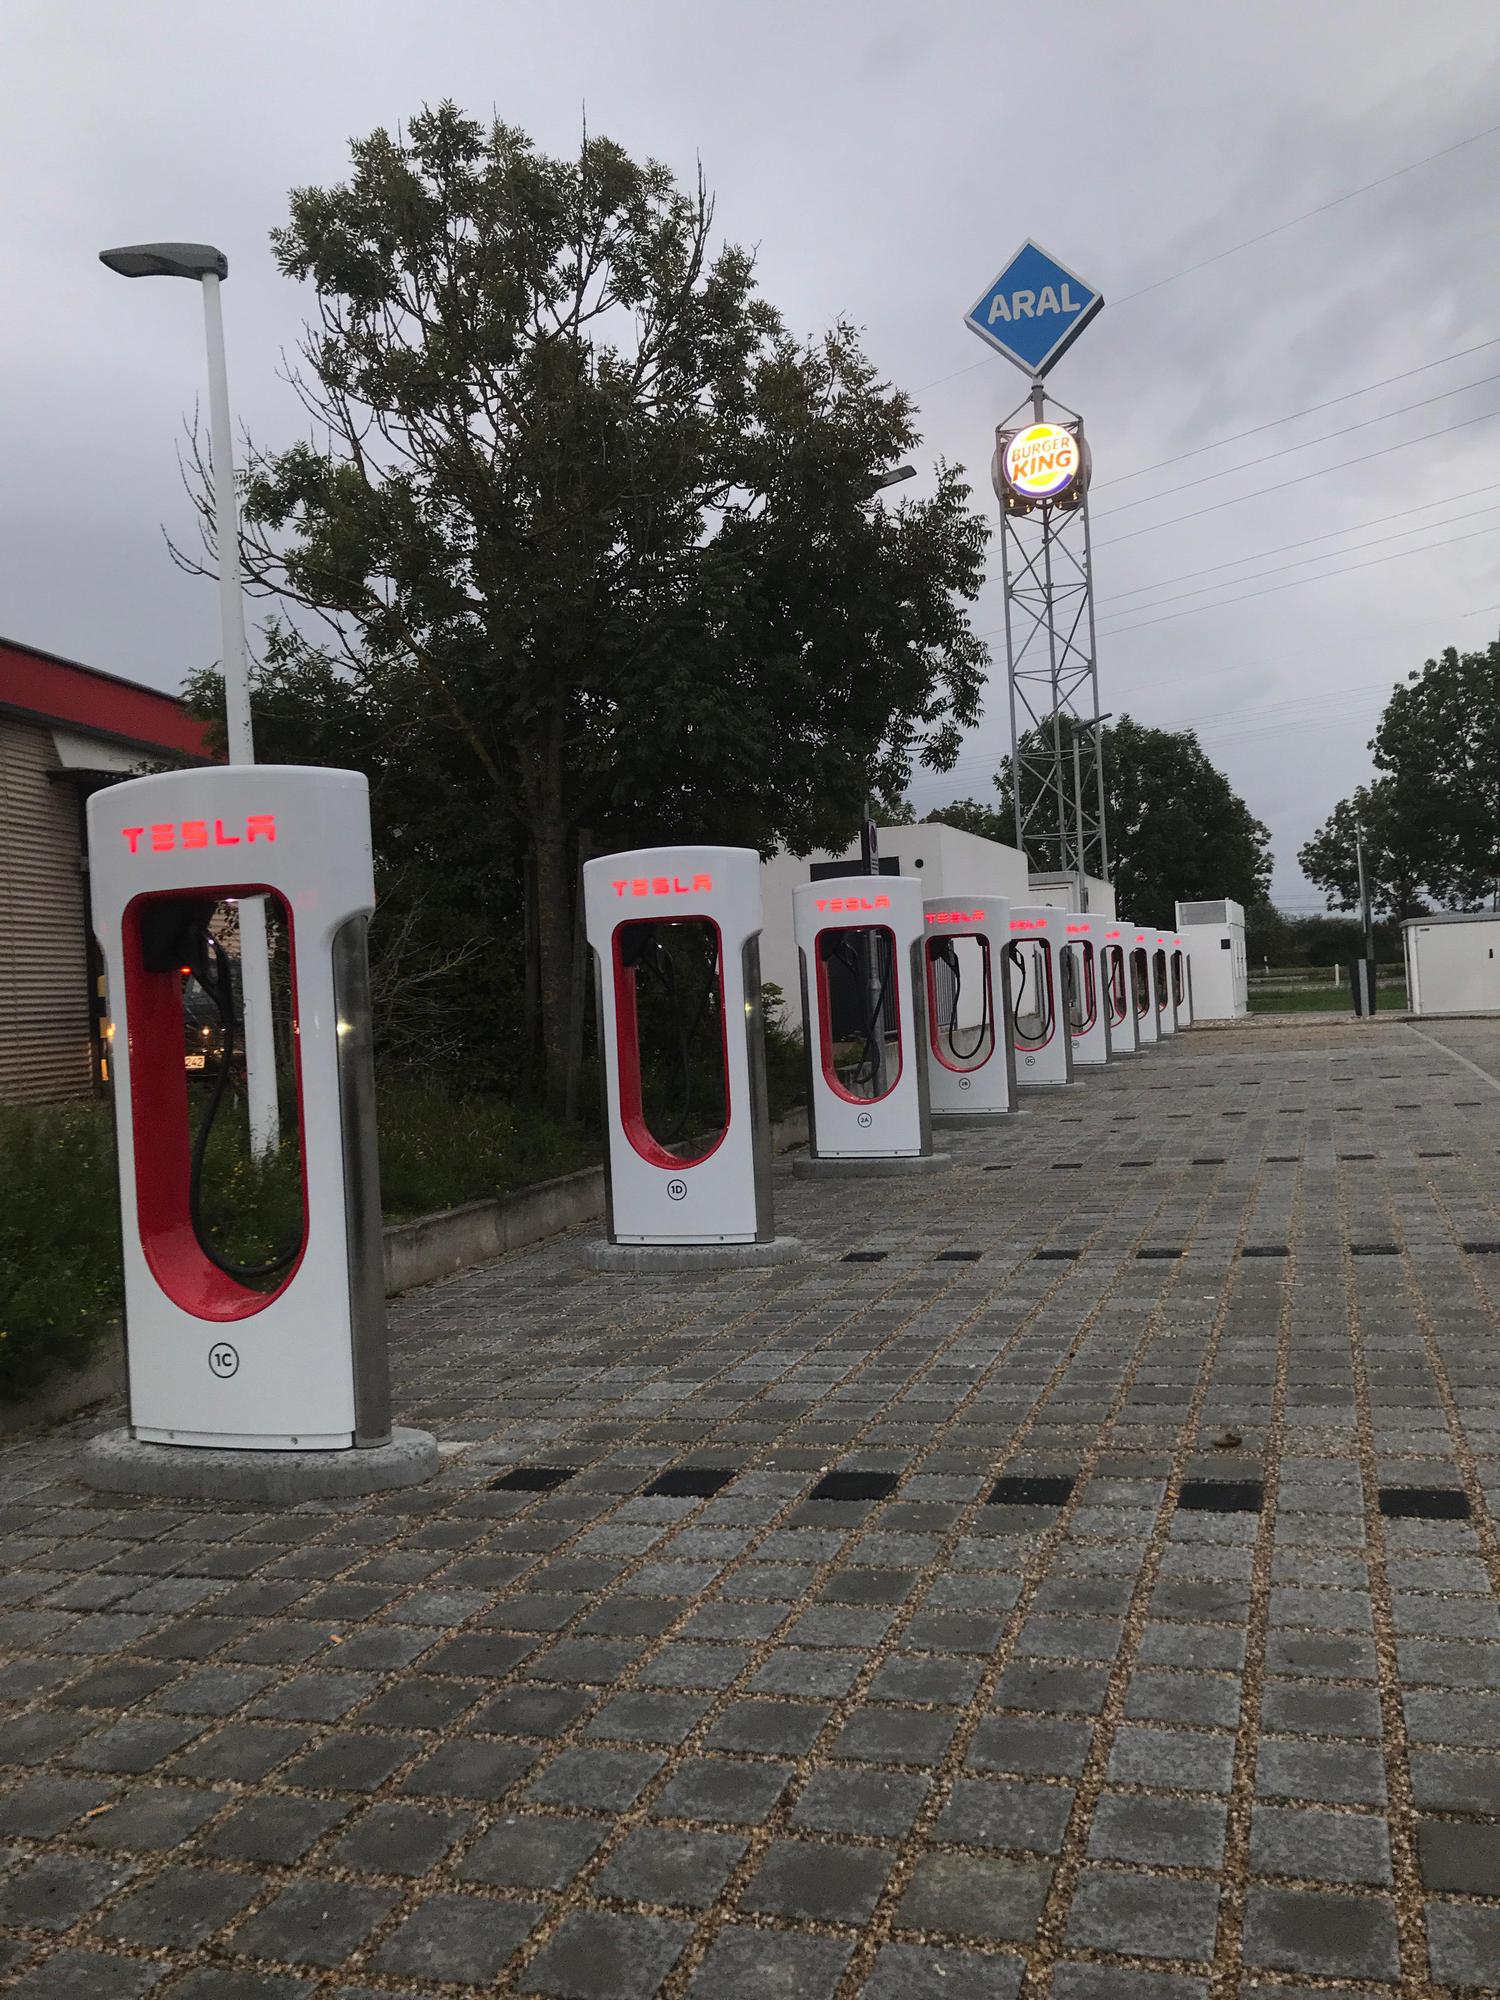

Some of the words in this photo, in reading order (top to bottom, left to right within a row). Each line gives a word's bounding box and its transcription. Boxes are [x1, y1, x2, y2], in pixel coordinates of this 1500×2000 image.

[987, 282, 1081, 325] ARAL
[1012, 437, 1070, 462] BURGER
[1013, 450, 1072, 481] KING
[121, 814, 277, 854] TESLA
[611, 873, 713, 898] TESLA
[815, 895, 891, 913] TESLA
[925, 909, 986, 924] TESLA
[671, 1185, 683, 1194] 1D
[215, 1353, 232, 1367] 1C
